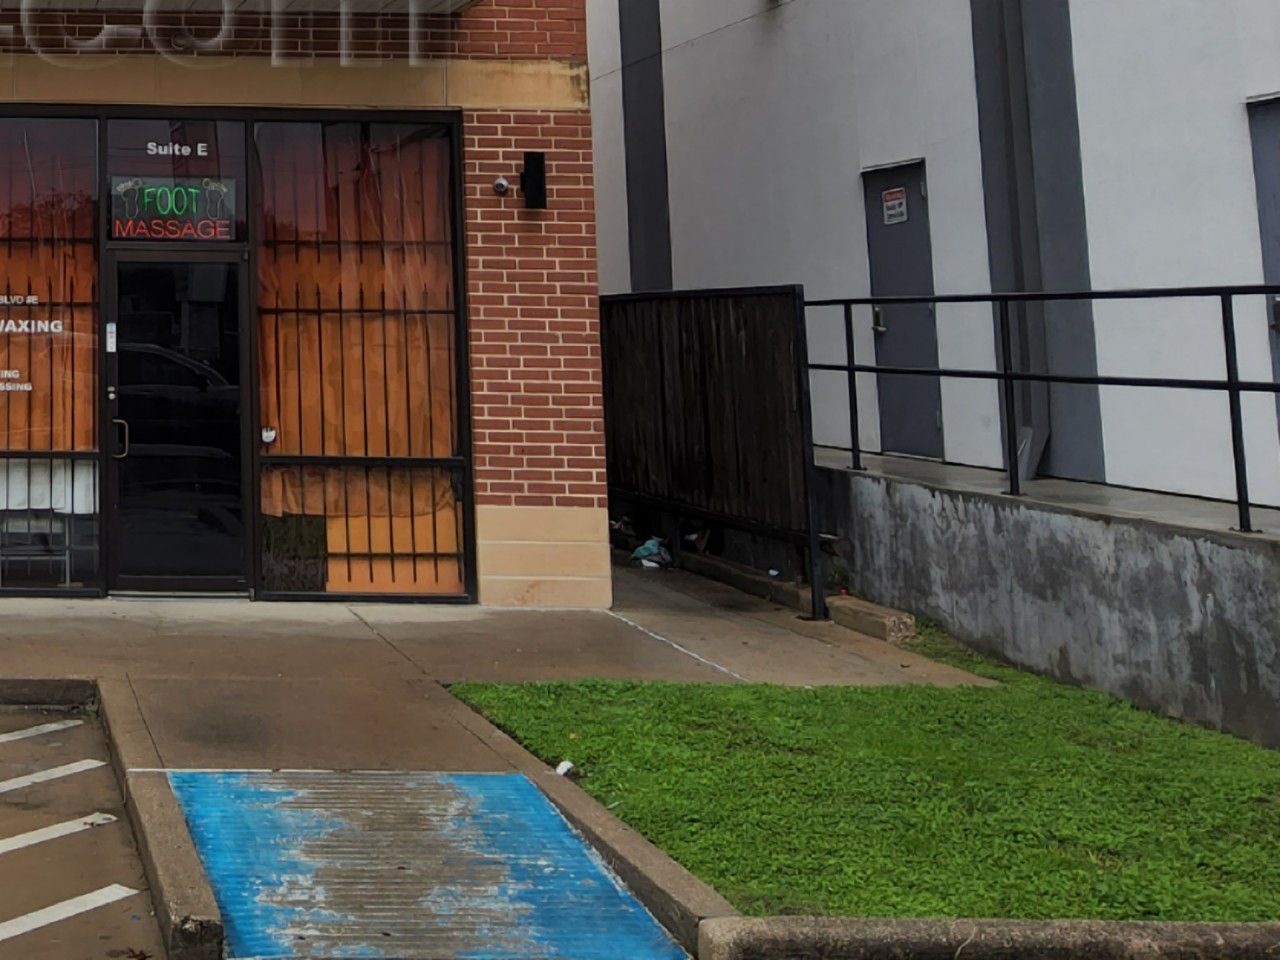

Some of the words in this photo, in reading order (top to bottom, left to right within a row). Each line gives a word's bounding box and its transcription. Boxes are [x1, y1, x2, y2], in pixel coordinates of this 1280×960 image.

[147, 142, 191, 156] Suite
[197, 143, 208, 156] E
[143, 186, 201, 215] FOOT
[114, 219, 231, 240] MASSAGE
